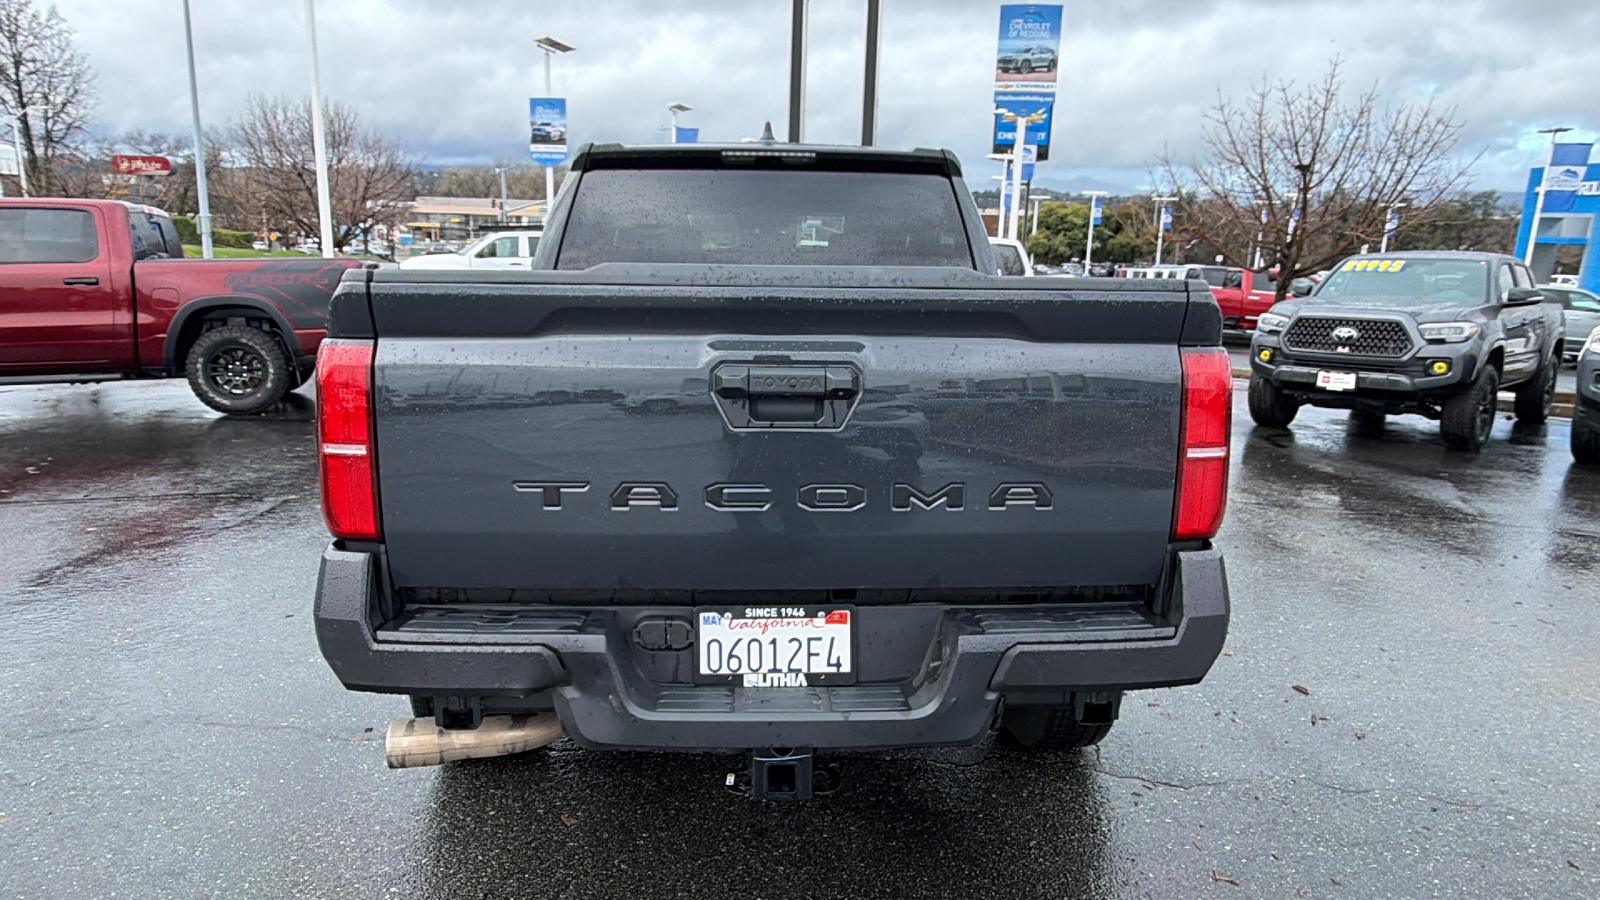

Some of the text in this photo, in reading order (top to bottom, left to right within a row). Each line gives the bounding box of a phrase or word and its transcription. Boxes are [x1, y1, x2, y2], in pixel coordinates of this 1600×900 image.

[1009, 22, 1051, 31] CHEVROLET
[1008, 30, 1051, 38] OF REDDING
[753, 375, 824, 392] TOYOTA
[512, 479, 1055, 512] TACOMA
[745, 607, 806, 618] SINCE 1946
[702, 615, 722, 626] MAY
[727, 618, 826, 636] California
[706, 636, 843, 673] 06012F4
[758, 673, 808, 687] LITHIA
